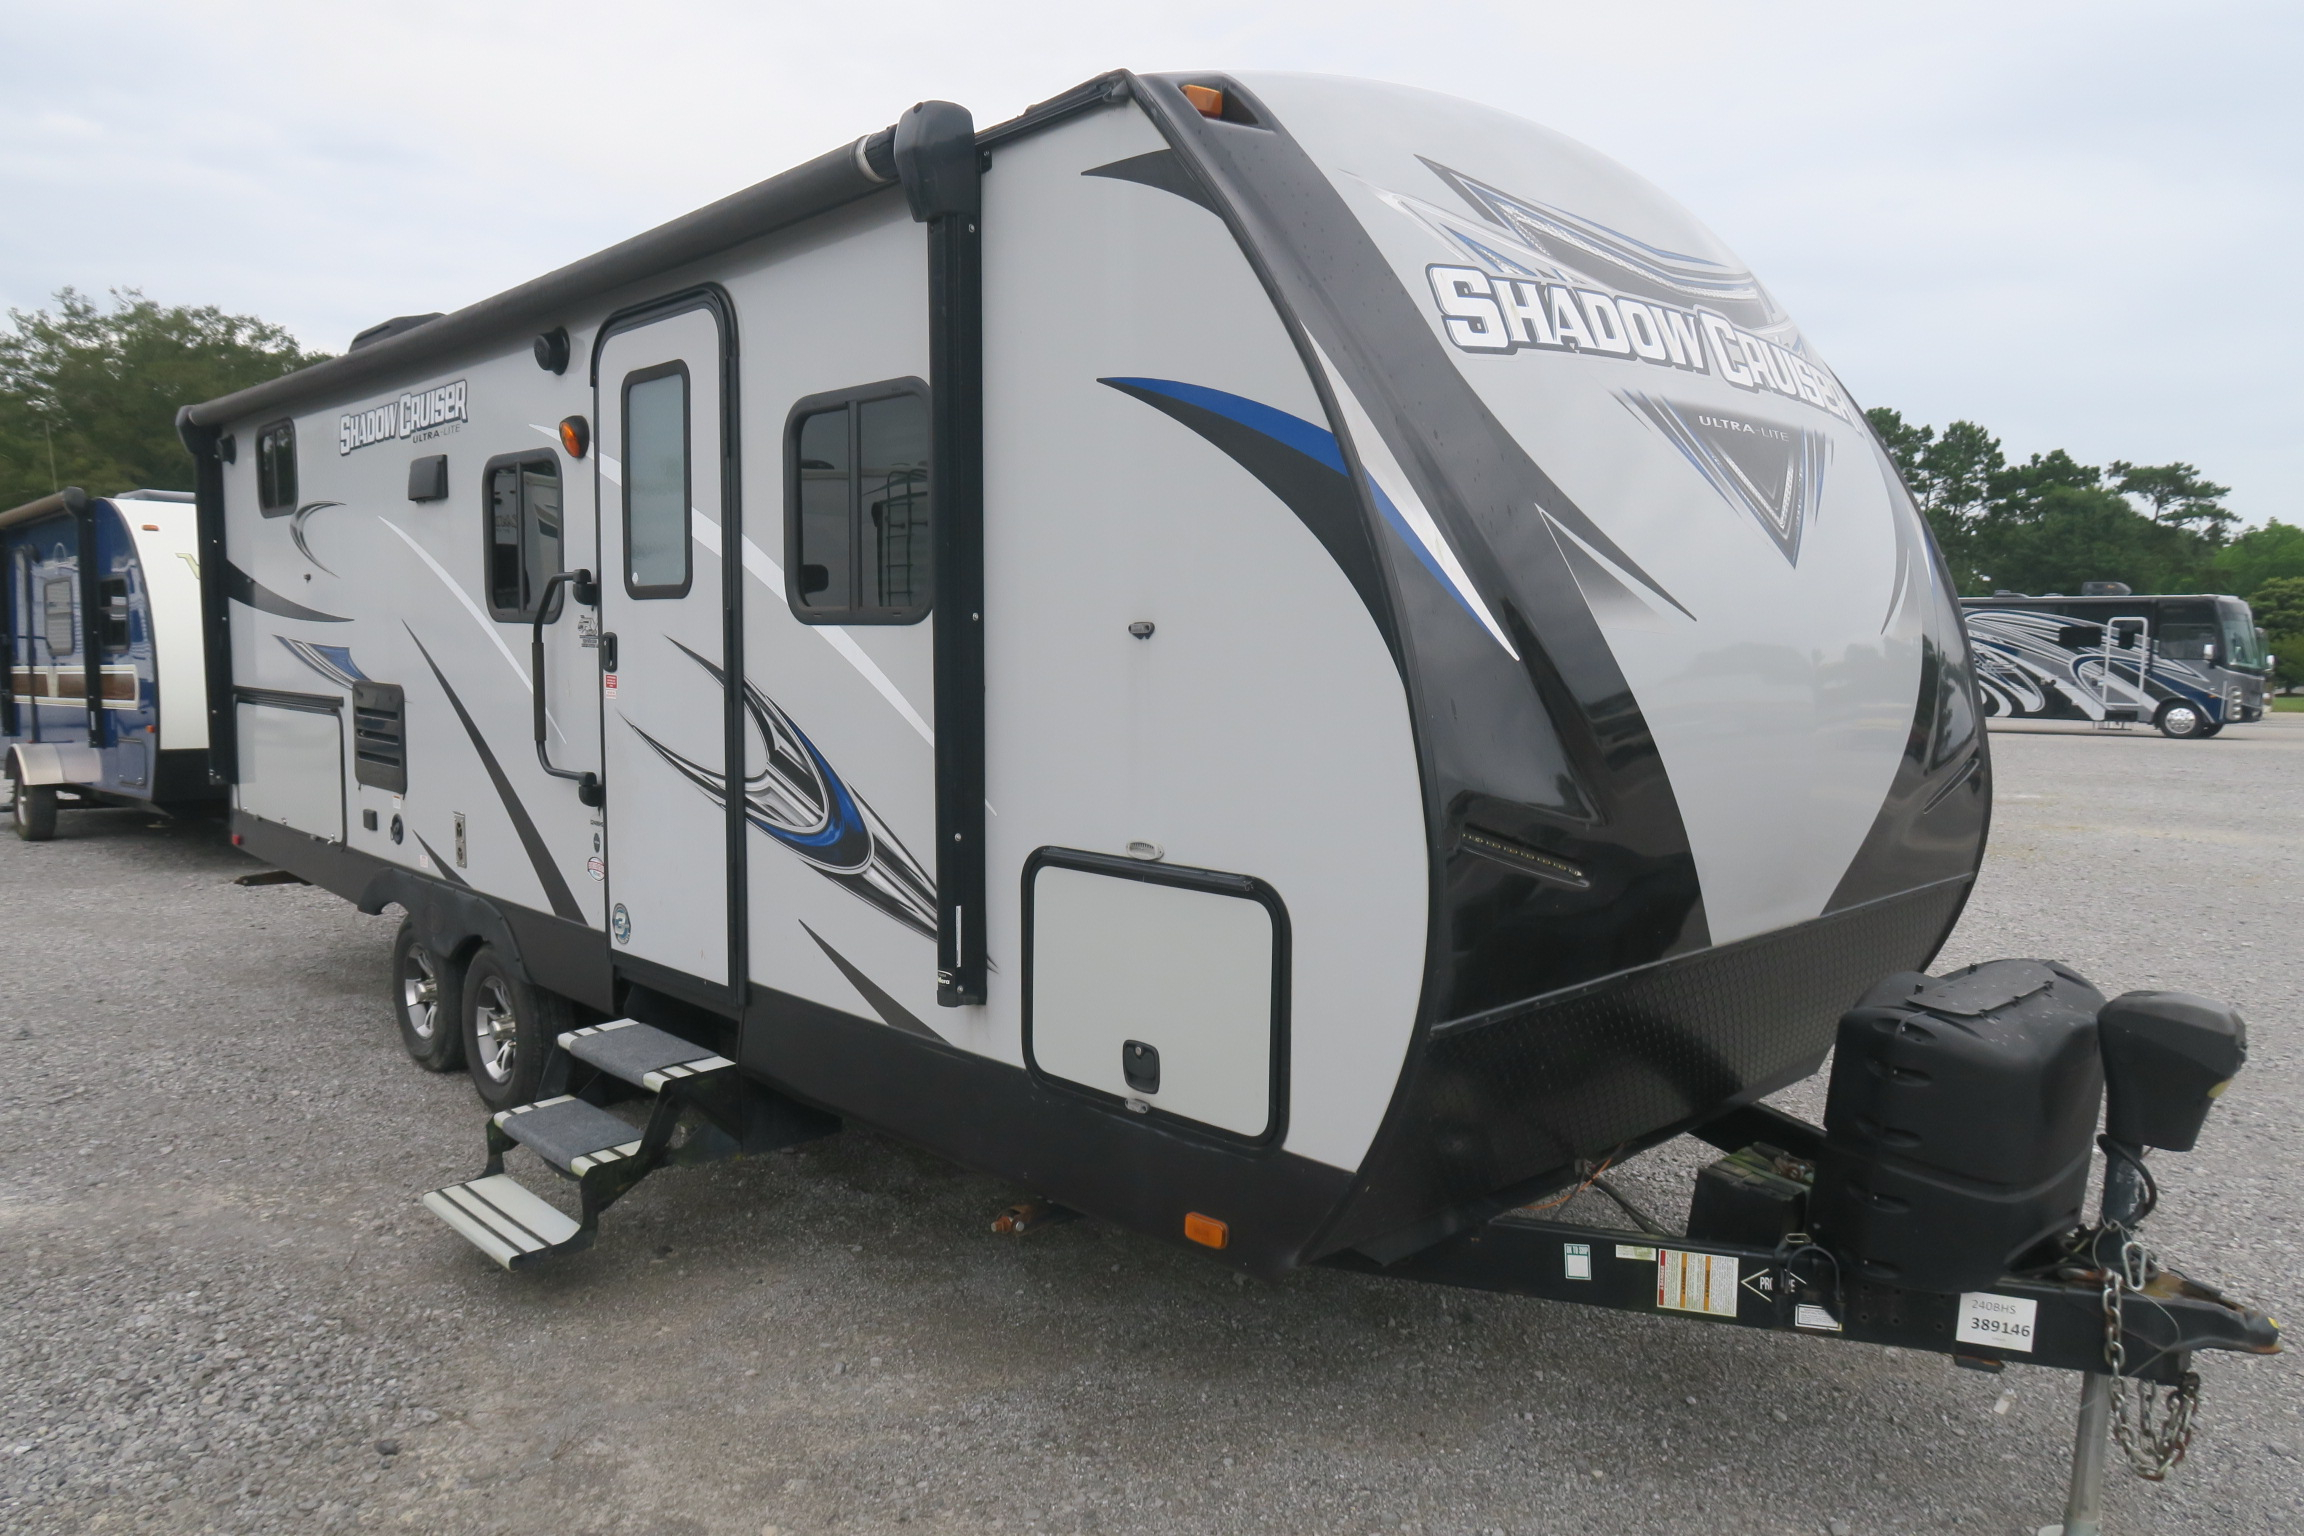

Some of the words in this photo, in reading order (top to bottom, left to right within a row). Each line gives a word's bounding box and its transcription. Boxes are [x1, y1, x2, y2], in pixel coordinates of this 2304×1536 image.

[1428, 265, 1708, 374] SHADOW
[340, 402, 399, 455] SHADOW
[400, 379, 467, 438] CRUISER
[1698, 415, 1790, 442] ULTRA-LITE
[412, 423, 461, 443] ULTRA-LITE
[1971, 1299, 2017, 1314] 240BHS
[1971, 1317, 2031, 1337] 389146
